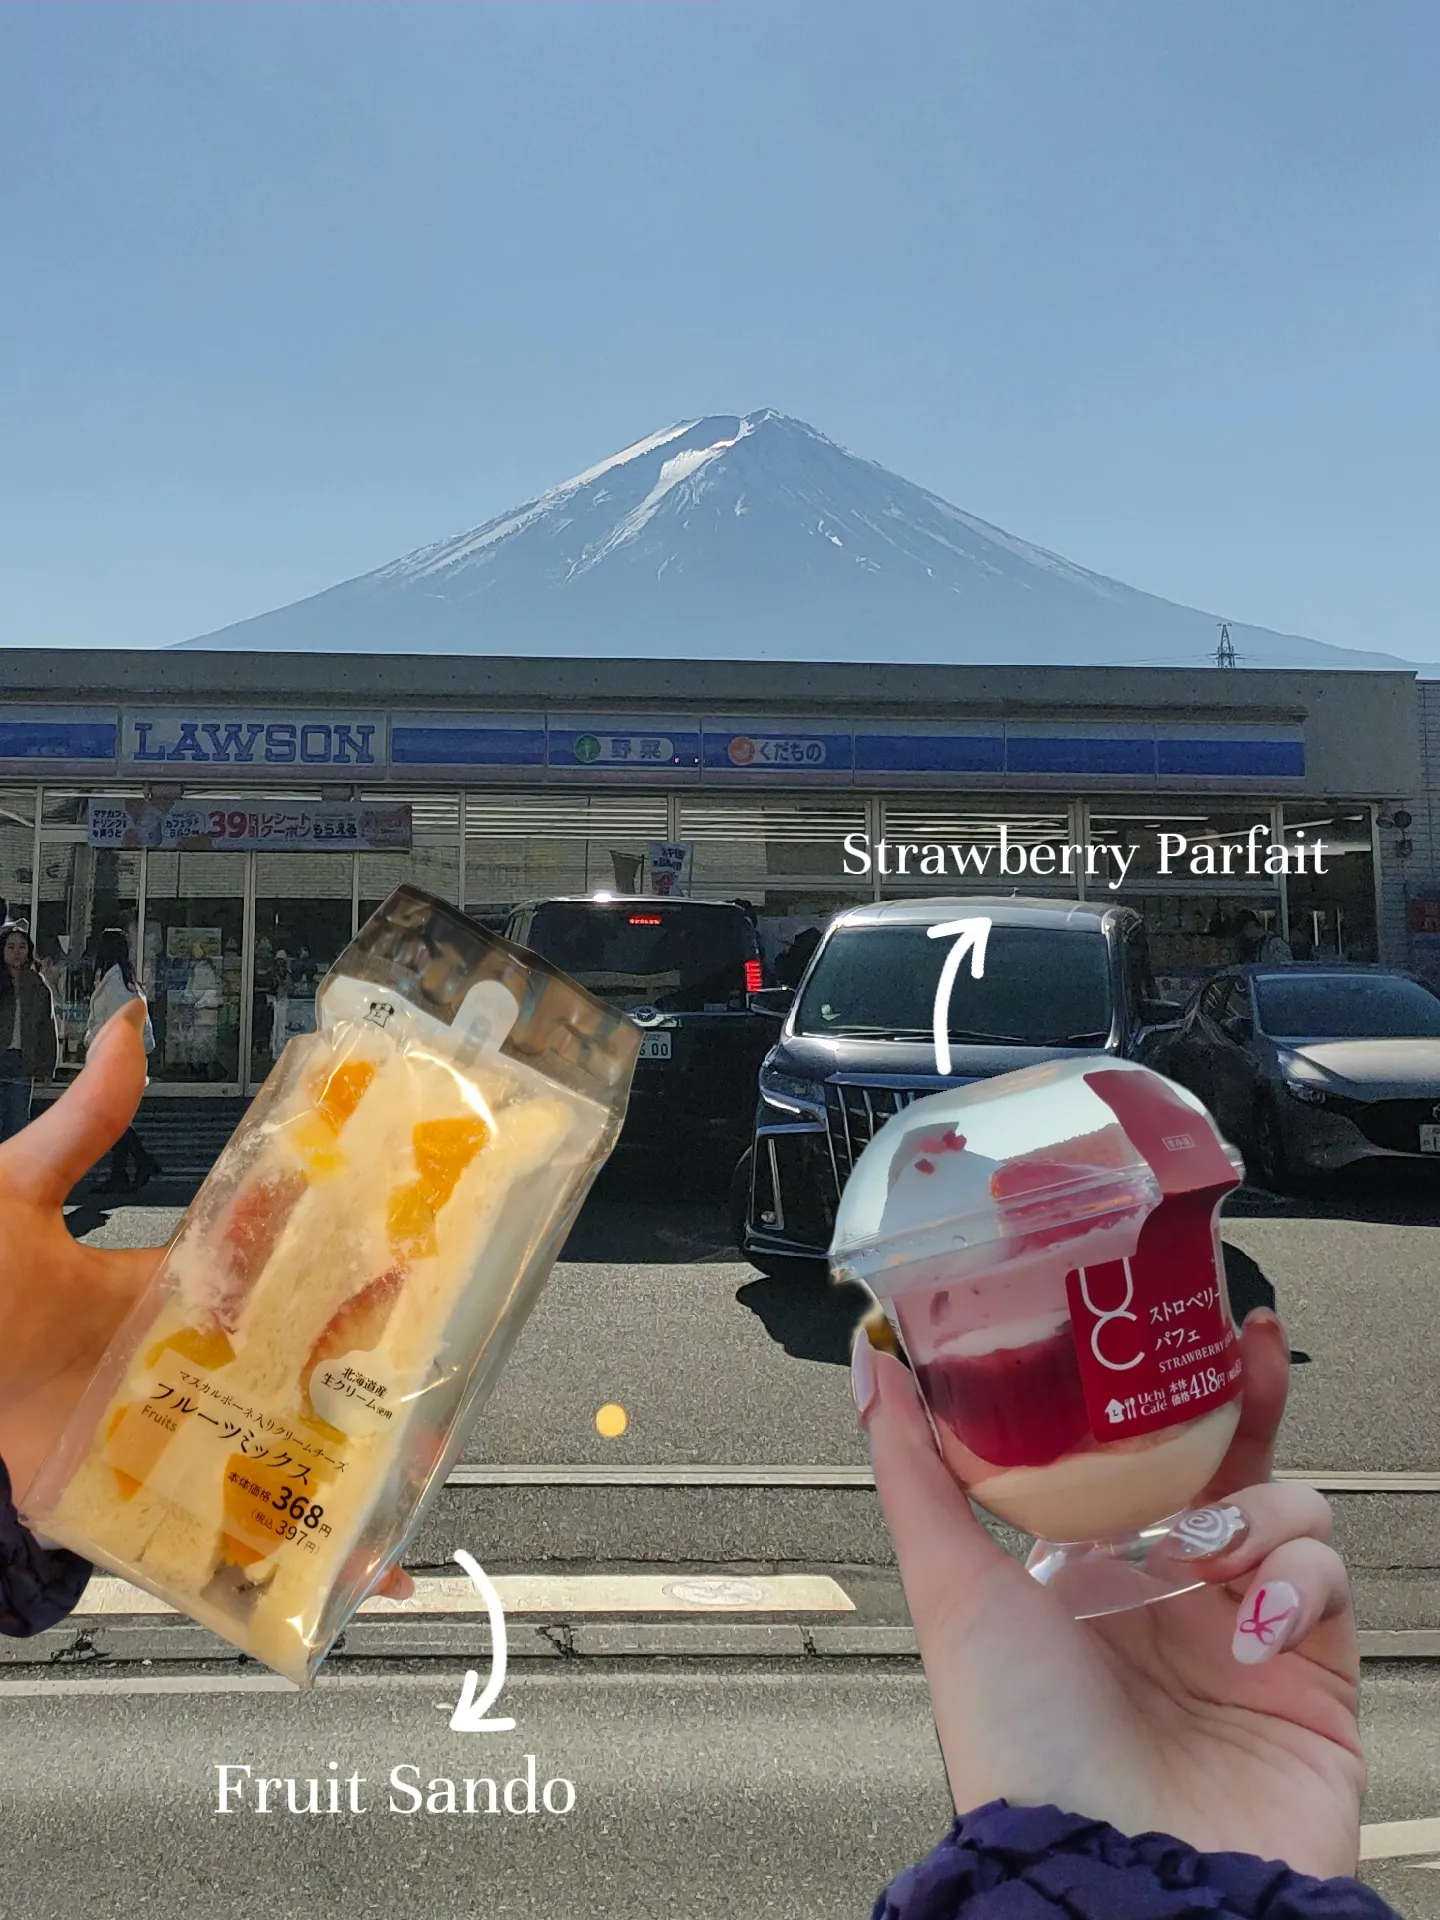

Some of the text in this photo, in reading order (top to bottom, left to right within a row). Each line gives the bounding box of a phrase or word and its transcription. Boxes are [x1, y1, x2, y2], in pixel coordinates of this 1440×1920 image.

[134, 723, 375, 763] LAWSON
[610, 738, 662, 760] 野菜
[759, 742, 822, 763] くだもの
[1155, 1328, 1201, 1351] パフェ
[1158, 1342, 1225, 1374] STRAWBERRY
[341, 1367, 388, 1400] 北海道産
[1138, 1388, 1165, 1405] Uchi
[141, 1405, 178, 1432] Fruits
[179, 1370, 349, 1473] マスカルポーネ入りクリームチーズ
[1140, 1400, 1168, 1416] Café
[150, 1383, 313, 1486] フルーツミックス
